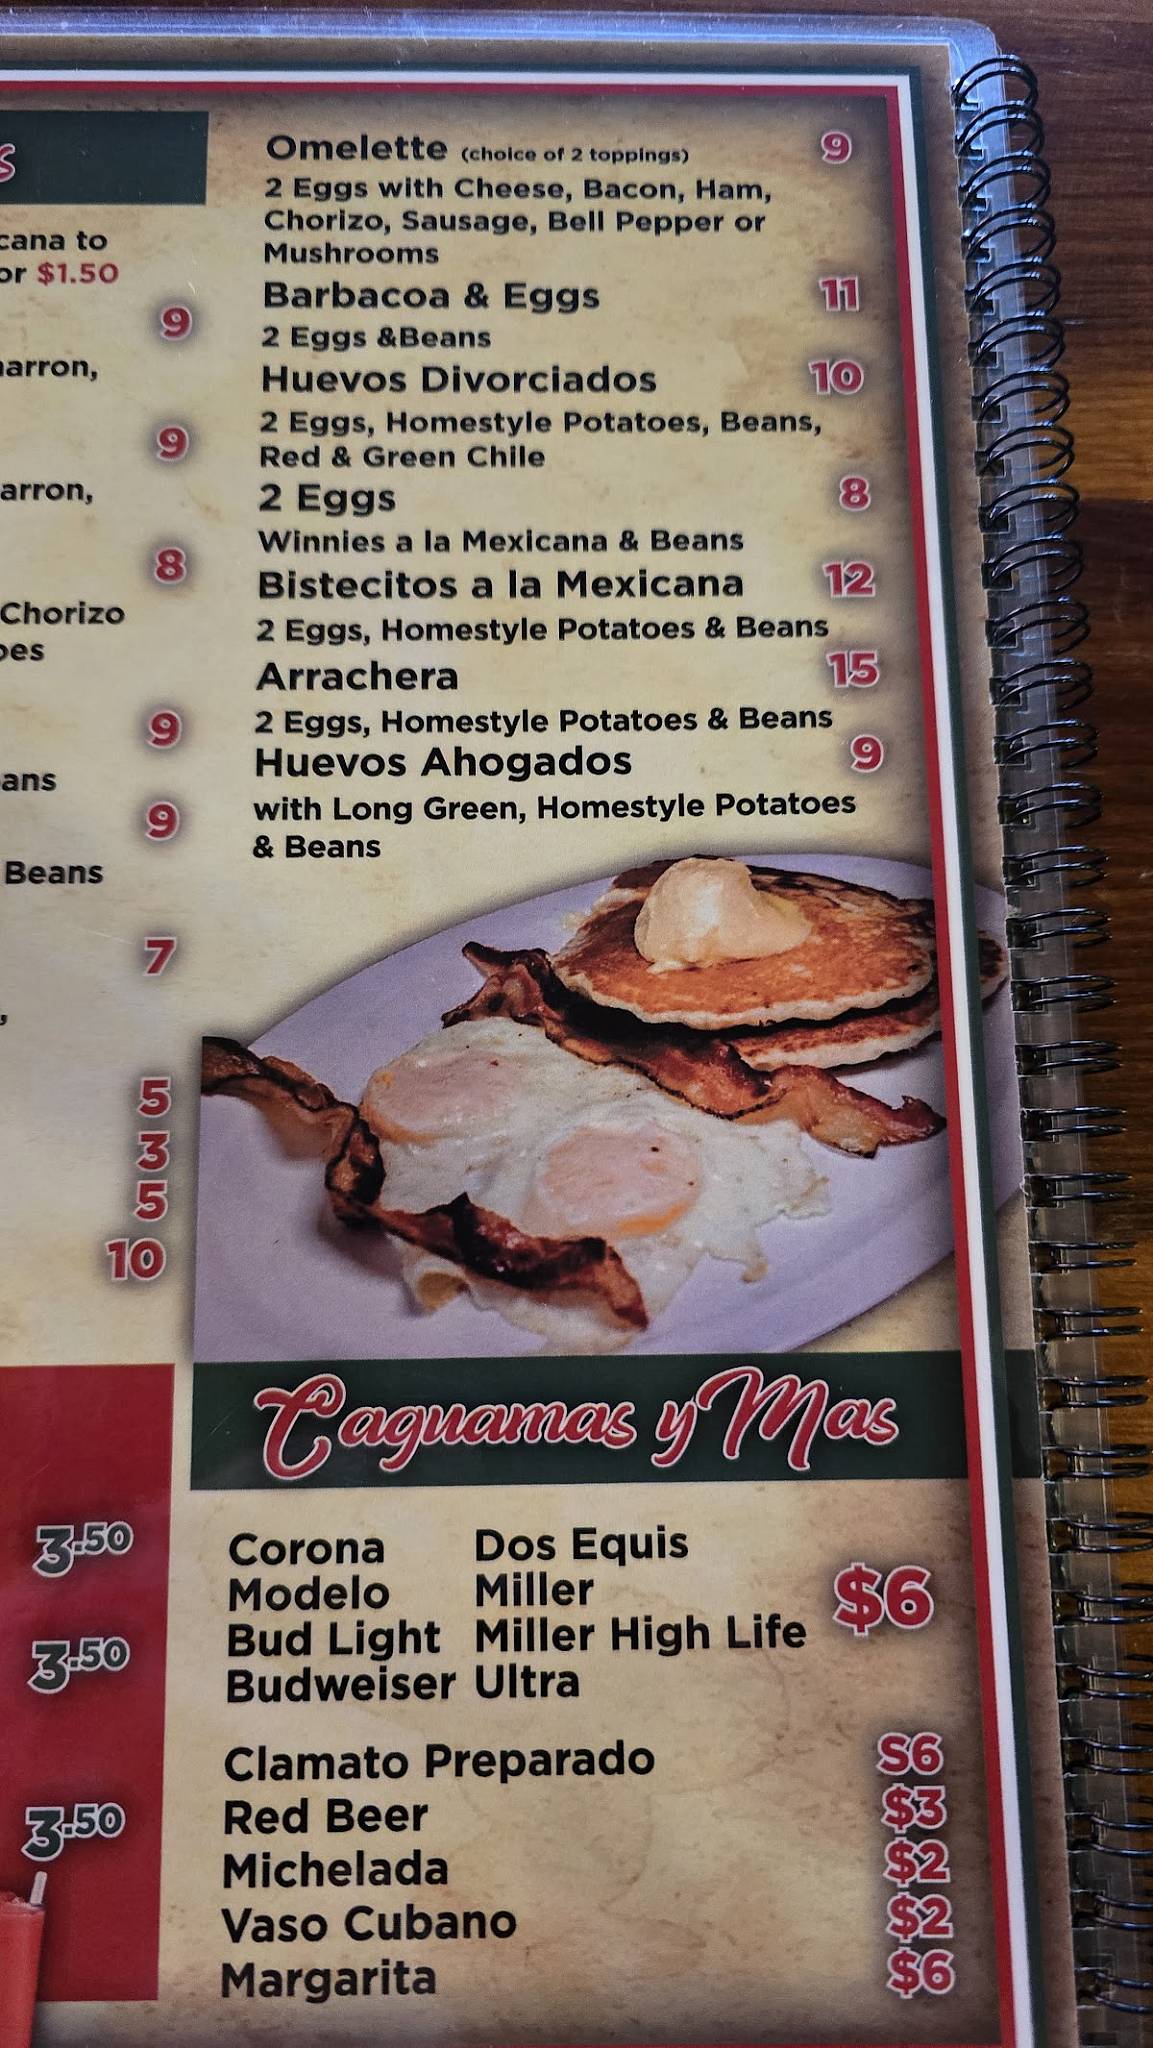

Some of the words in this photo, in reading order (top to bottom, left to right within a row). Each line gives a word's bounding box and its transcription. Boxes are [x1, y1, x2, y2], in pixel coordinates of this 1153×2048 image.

[266, 133, 448, 162] Omelette
[461, 145, 537, 164] (choice
[543, 146, 565, 162] of
[571, 146, 583, 162] 2
[589, 146, 689, 165] toppings)
[821, 132, 852, 164] 9
[264, 176, 283, 199] 2
[293, 176, 369, 203] Eggs
[377, 175, 444, 199] with
[454, 176, 573, 204] Cheese,
[583, 177, 685, 204] Bacon,
[695, 178, 772, 205] Ham,
[0, 233, 66, 251] cana
[75, 229, 108, 252] to
[264, 208, 391, 236] Chorizo,
[401, 209, 537, 237] Sausage,
[548, 209, 605, 233] Bell
[616, 210, 725, 237] Pepper
[734, 214, 767, 233] or
[264, 241, 440, 265] Mushrooms
[0, 266, 28, 285] or
[37, 262, 119, 286] $1.50
[263, 279, 450, 310] Barbacoa
[463, 280, 490, 310] &
[504, 280, 601, 316] Eggs
[819, 276, 860, 311] 11
[160, 305, 193, 340] 9
[261, 324, 280, 348] 2
[290, 325, 367, 353] Eggs
[376, 324, 492, 349] &Beans
[0, 359, 98, 383] arron,
[262, 364, 407, 394] Huevos
[421, 364, 657, 394] Divorciados
[808, 361, 865, 395] 10
[259, 409, 278, 434] 2
[289, 410, 375, 439] Eggs,
[386, 409, 553, 438] Homestyle
[563, 410, 709, 438] Potatoes,
[720, 409, 822, 437] Beans,
[156, 426, 189, 461] 9
[259, 444, 321, 469] Red
[331, 445, 352, 469] &
[362, 444, 456, 469] Green
[466, 444, 546, 469] Chile
[0, 482, 94, 506] arron,
[258, 482, 282, 513] 2
[297, 482, 397, 518] Eggs
[839, 476, 871, 511] 8
[256, 528, 386, 554] Winnies
[395, 533, 413, 554] a
[424, 528, 451, 554] la
[462, 527, 608, 553] Mexicana
[618, 528, 639, 553] &
[650, 527, 744, 553] Beans
[154, 547, 187, 584] 8
[258, 569, 458, 601] Bistecitos
[471, 575, 493, 600] a
[508, 568, 542, 600] la
[557, 567, 744, 599] Mexicana
[823, 561, 876, 598] 12
[0, 600, 126, 626] Chorizo
[255, 617, 275, 643] 2
[285, 618, 371, 647] Eggs,
[381, 616, 548, 646] Homestyle
[558, 616, 696, 642] Potatoes
[704, 615, 727, 640] &
[735, 615, 830, 639] Beans
[255, 659, 459, 692] Arrachera
[827, 649, 881, 689] 15
[146, 710, 181, 748] 9
[253, 710, 274, 735] 2
[284, 710, 371, 739] Eggs,
[381, 708, 549, 739] Homestyle
[559, 708, 699, 733] Potatoes
[707, 706, 729, 731] &
[739, 706, 834, 731] Beans
[255, 747, 407, 778] Huevos
[420, 744, 633, 783] Ahogados
[851, 736, 884, 773] 9
[0, 772, 57, 792] ans
[144, 802, 180, 840] 9
[252, 795, 322, 822] with
[333, 796, 413, 826] Long
[423, 795, 527, 825] Green,
[537, 792, 706, 823] Homestyle
[715, 791, 857, 817] Potatoes
[251, 834, 275, 859] &
[285, 834, 382, 859] Beans
[3, 860, 104, 885] Beans
[144, 938, 177, 976] 7
[138, 1078, 171, 1119] 5
[136, 1131, 170, 1172] 3
[134, 1181, 168, 1222] 5
[106, 1238, 166, 1281] 10
[254, 1373, 637, 1481] Caguamas
[652, 1395, 699, 1469] y
[695, 1365, 899, 1471] Mas
[32, 1521, 134, 1576] 3.50
[228, 1531, 385, 1567] Corona
[475, 1528, 557, 1562] Dos
[572, 1523, 689, 1568] Equis
[228, 1574, 390, 1613] Modelo
[475, 1570, 595, 1608] Miller
[833, 1561, 934, 1636] $6
[227, 1620, 312, 1658] Bud
[328, 1618, 441, 1662] Light
[475, 1616, 596, 1654] Miller
[611, 1613, 711, 1658] High
[726, 1612, 807, 1650] Life
[27, 1636, 131, 1694] 3.50
[475, 1662, 580, 1700] Ultra
[226, 1664, 457, 1705] Budweiser
[224, 1744, 409, 1783] Clamato
[425, 1738, 656, 1785] Preparado
[223, 1796, 309, 1836] Red
[326, 1797, 429, 1834] Beer
[881, 1784, 947, 1833] $3
[21, 1802, 126, 1862] 3.50
[222, 1848, 449, 1890] Michelada
[883, 1838, 951, 1886] $2
[220, 1907, 329, 1944] Vaso
[343, 1902, 518, 1942] Cubano
[885, 1893, 954, 1942] $2
[221, 1957, 437, 2004] Margarita
[886, 1947, 955, 1998] $6
